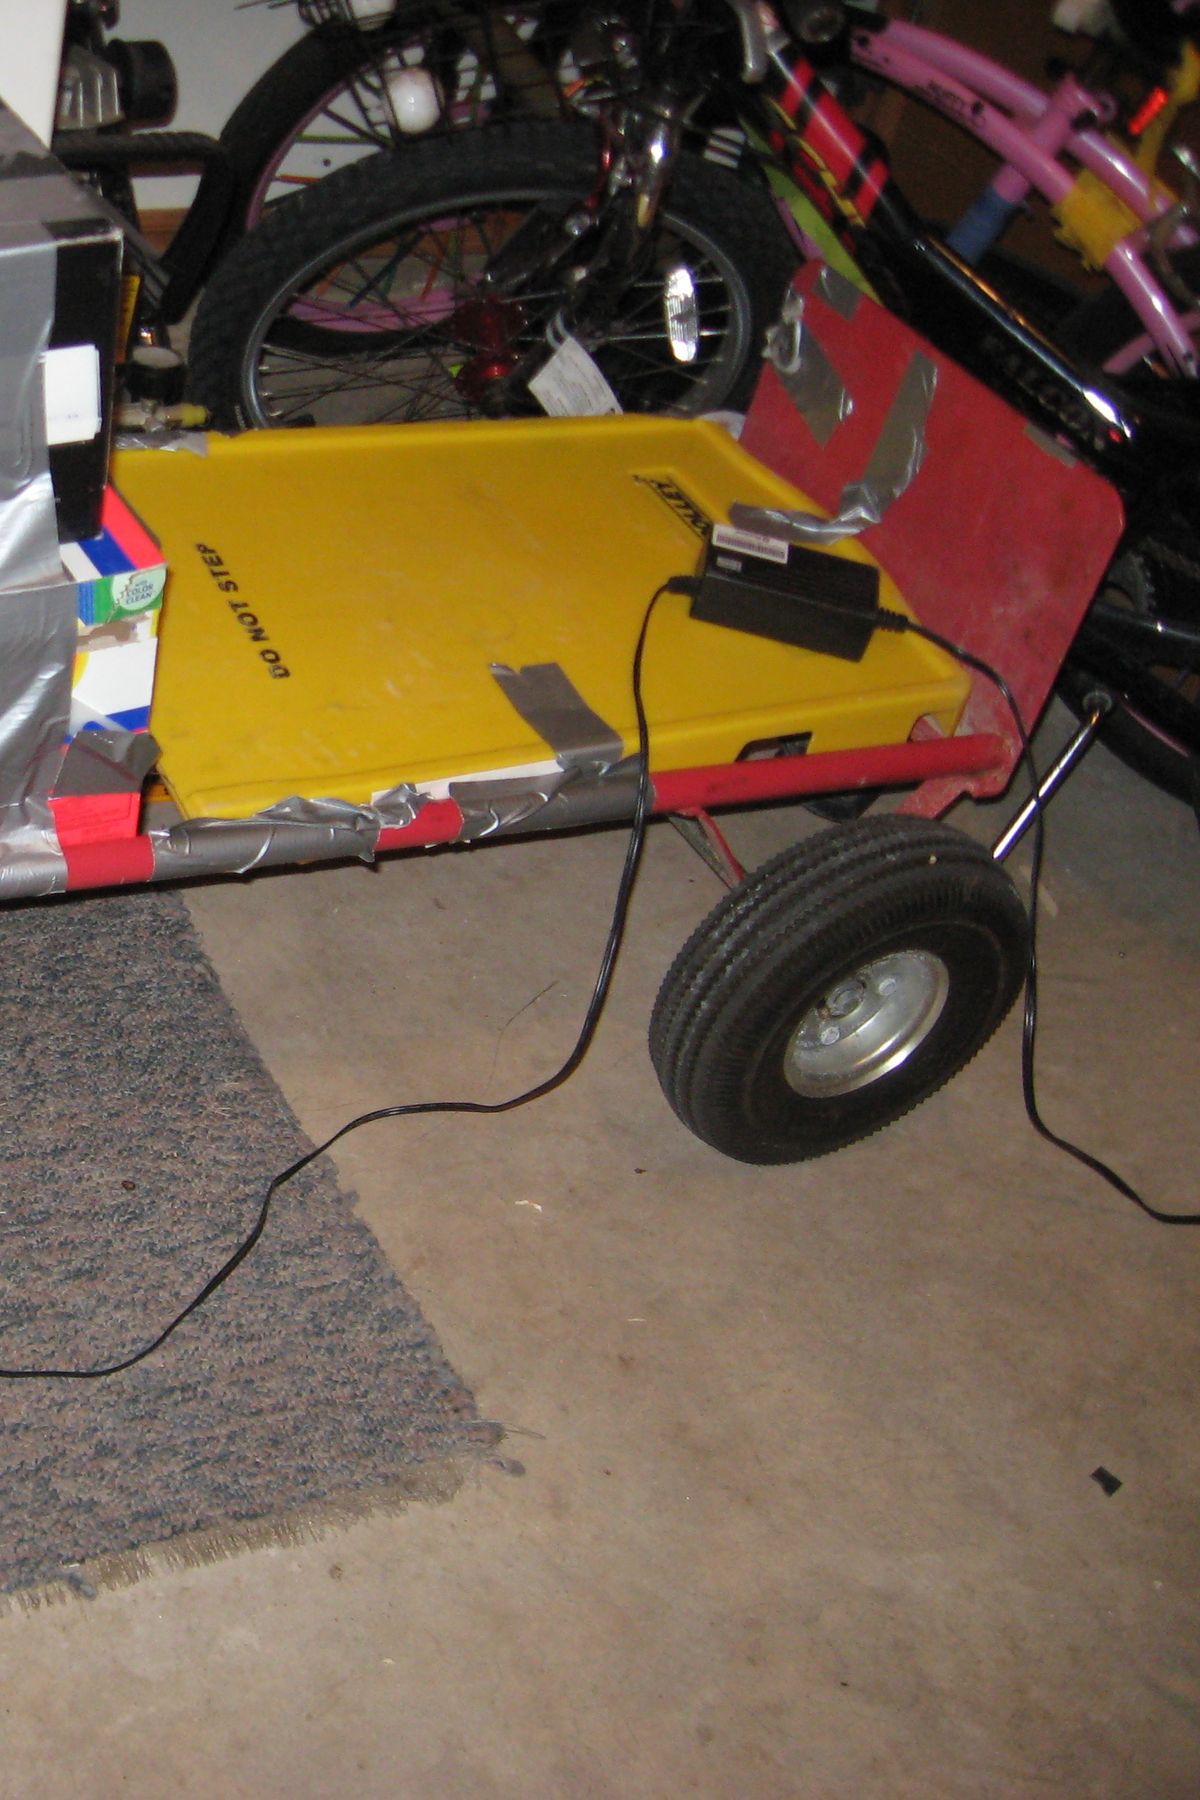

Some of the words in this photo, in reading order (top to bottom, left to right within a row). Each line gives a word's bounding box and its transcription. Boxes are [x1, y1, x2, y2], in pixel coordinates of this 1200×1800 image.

[195, 542, 239, 593] STEP
[227, 598, 270, 642] NOT
[259, 649, 291, 680] DO
